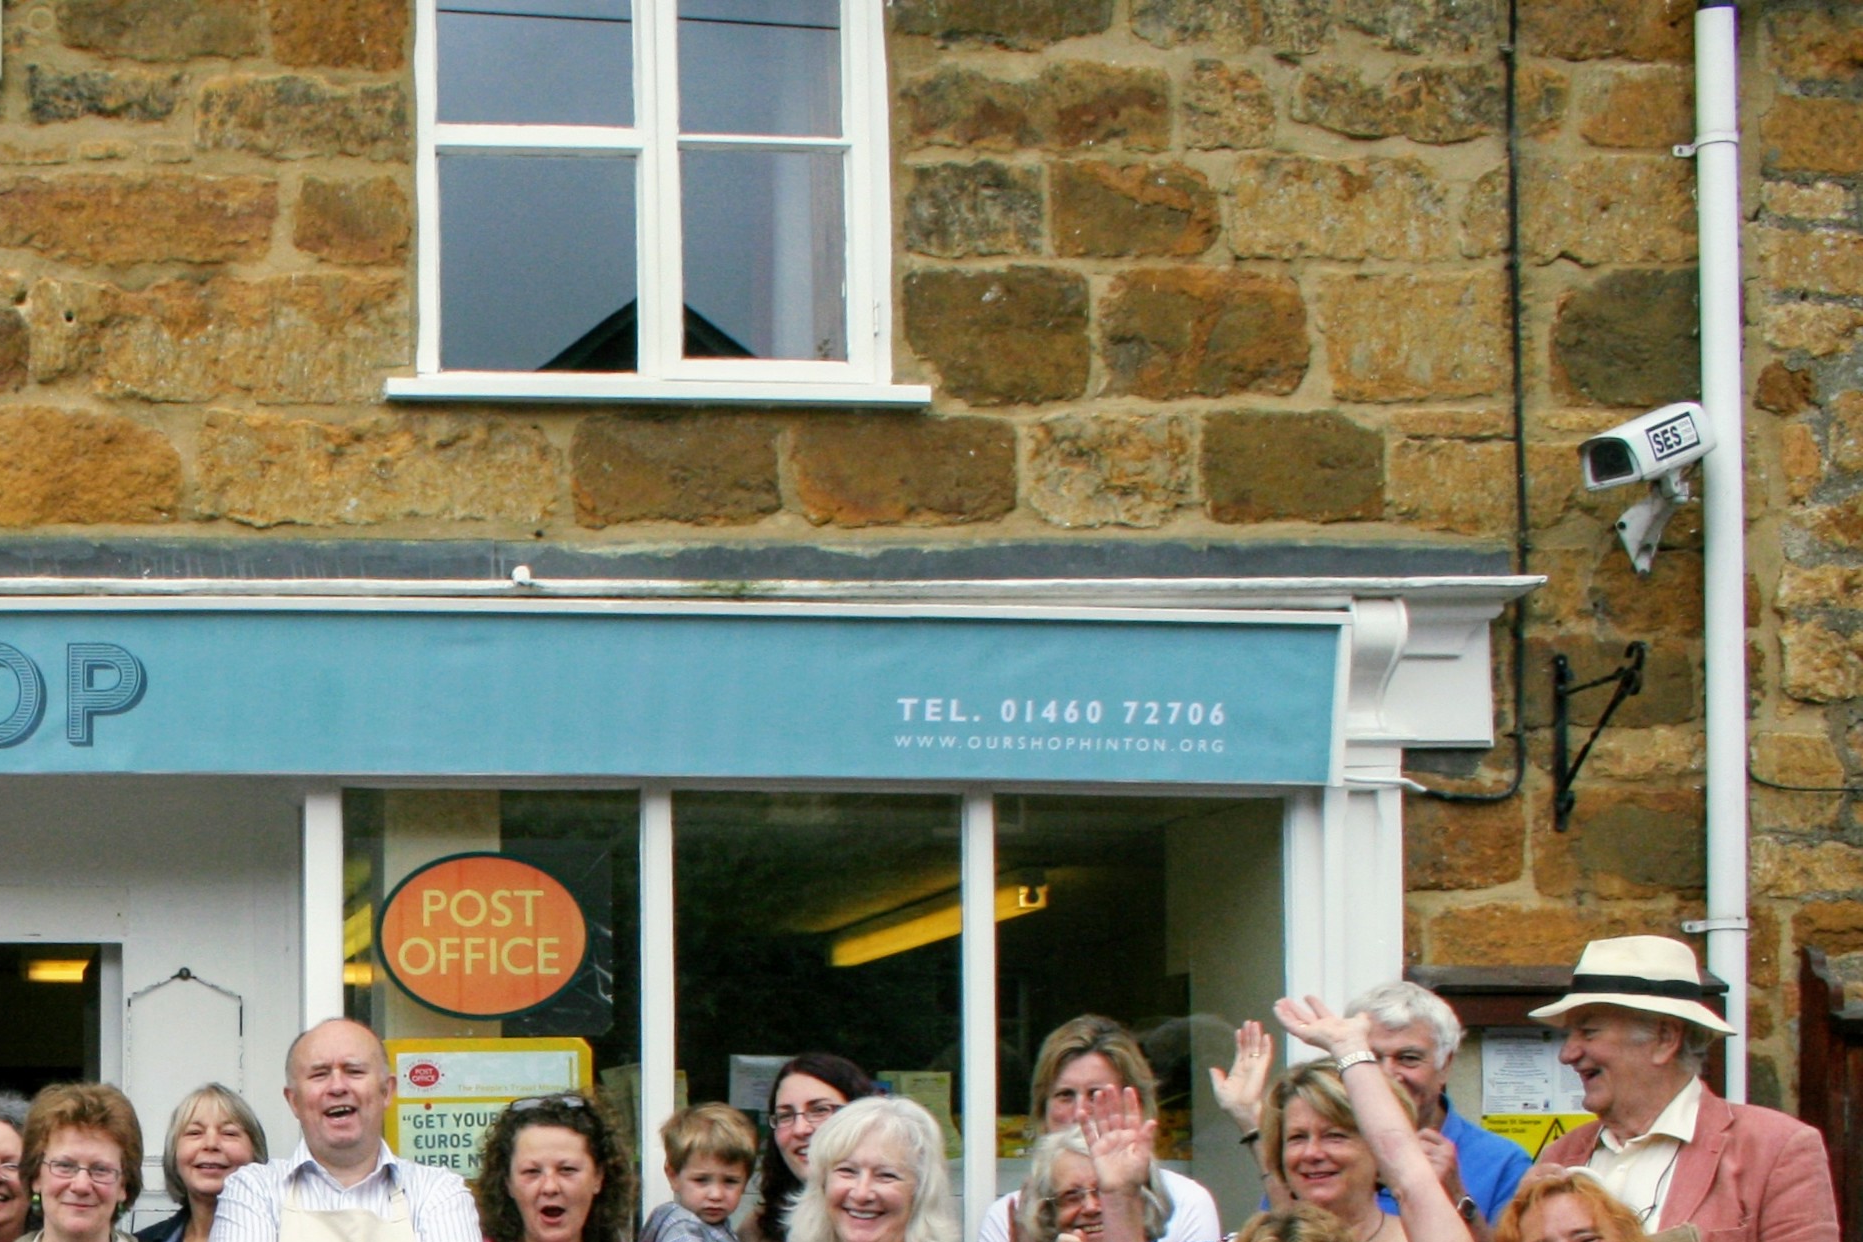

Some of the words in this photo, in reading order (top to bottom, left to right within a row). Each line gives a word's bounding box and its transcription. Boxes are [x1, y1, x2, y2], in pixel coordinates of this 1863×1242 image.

[1652, 425, 1682, 453] SES
[896, 697, 981, 723] TEL.
[1000, 699, 1103, 724] 01460
[1122, 701, 1225, 726] 72706
[894, 734, 1225, 753] WWW.OURSHOPHINTON.ORG
[422, 889, 545, 928] POST
[398, 936, 561, 976] OFFICE
[414, 1068, 434, 1076] POST
[414, 1153, 461, 1169] HERE
